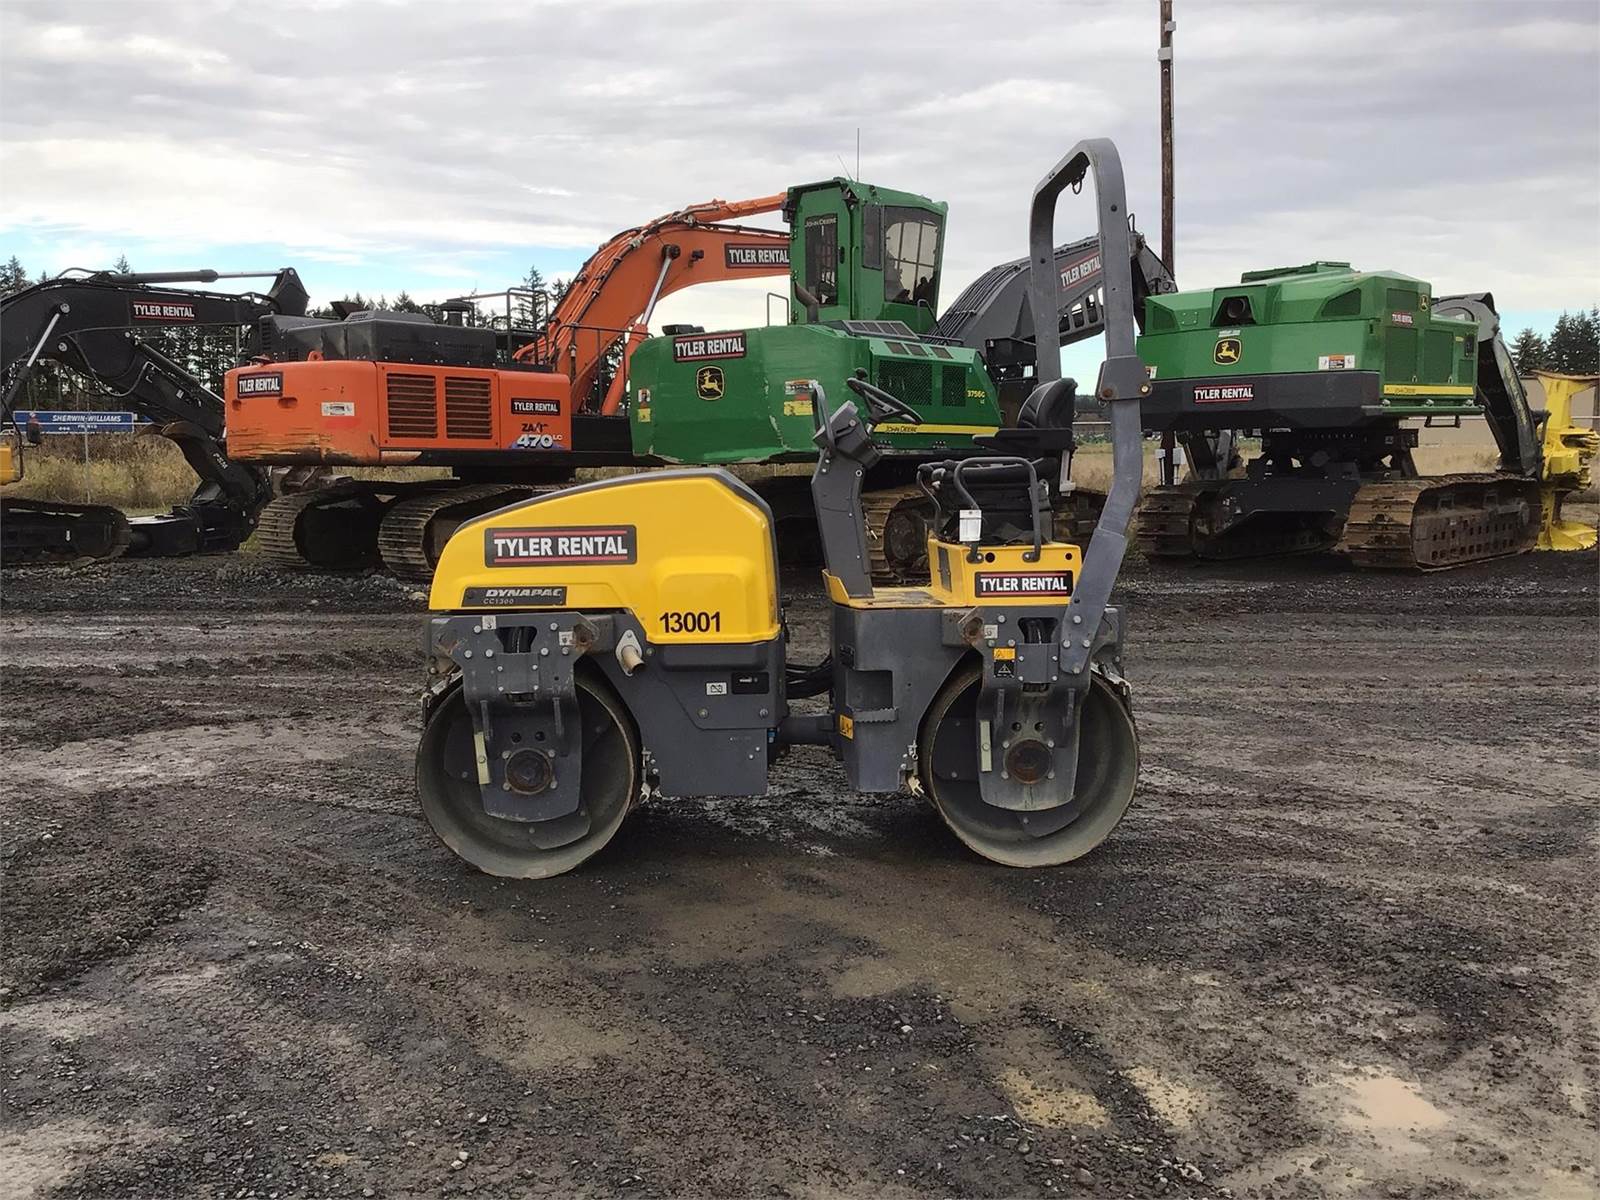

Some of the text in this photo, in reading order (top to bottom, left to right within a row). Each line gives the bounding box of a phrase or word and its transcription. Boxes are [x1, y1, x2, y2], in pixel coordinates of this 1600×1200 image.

[729, 249, 789, 263] TYLER RENTAL
[1060, 255, 1102, 287] TYLER RENTAL
[133, 304, 195, 317] TYLER RENTAL
[675, 337, 744, 357] TYLER RENTAL
[239, 377, 280, 393] TYLER RENTAL
[1194, 387, 1254, 400] TYLER RENTAL
[513, 401, 558, 412] TYLER RENTAL
[52, 414, 122, 422] SHERWIN-WILLIAMS
[516, 434, 553, 448] 470
[494, 536, 628, 557] TYLER RENTAL
[980, 577, 1067, 592] TYLER RENTAL
[485, 588, 563, 597] DYNAPAC
[659, 611, 721, 634] 13001
